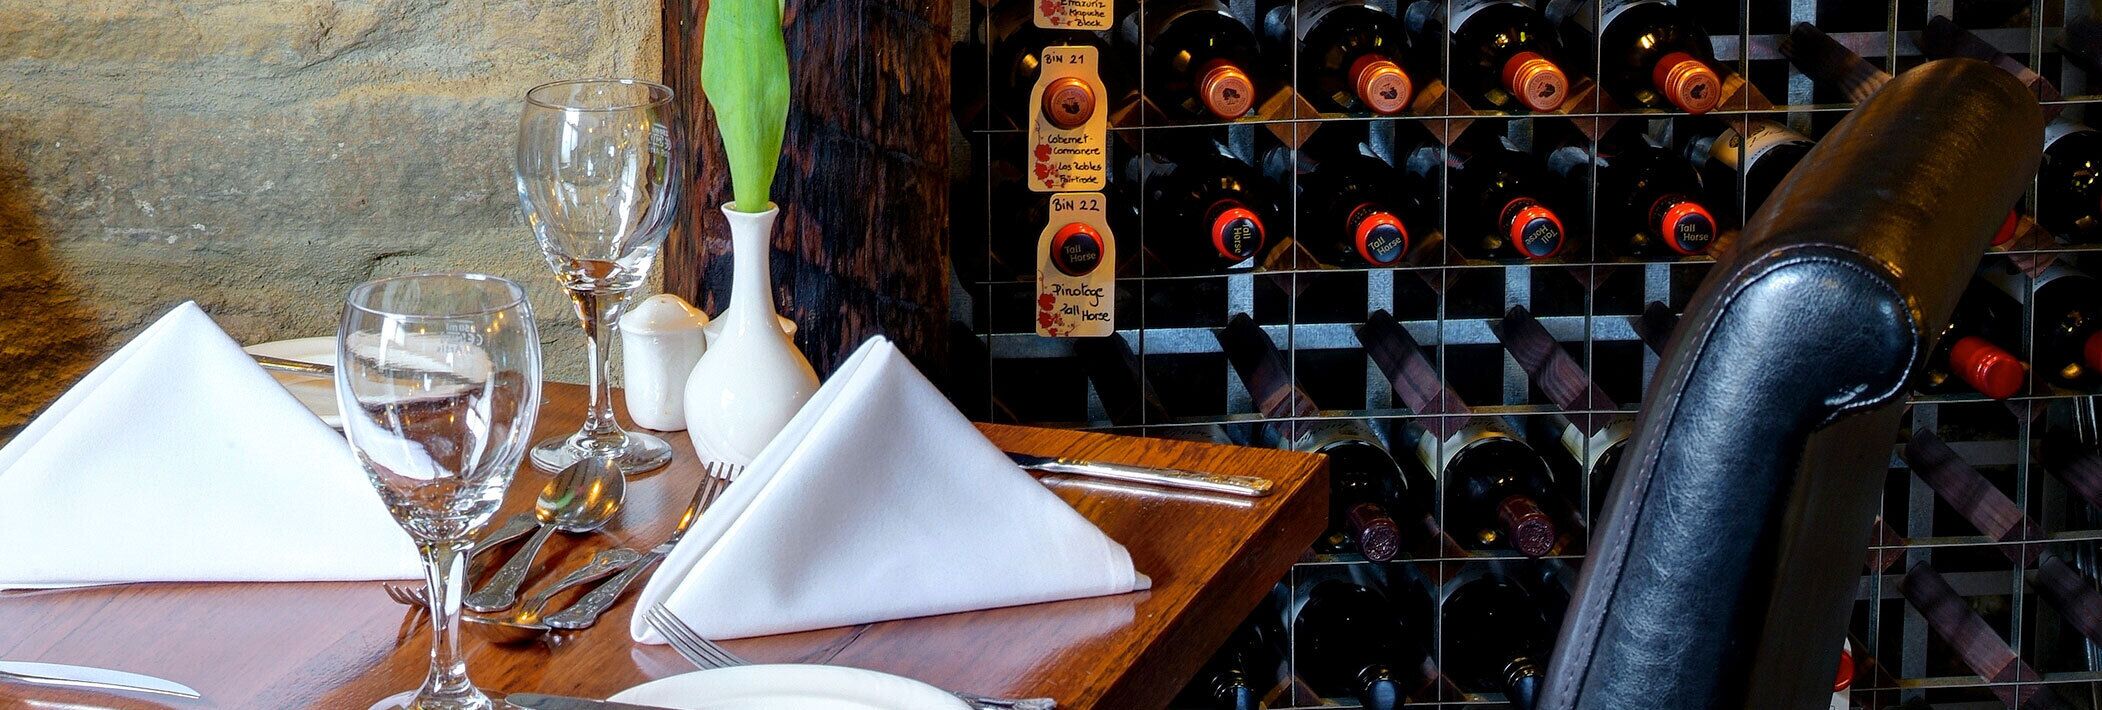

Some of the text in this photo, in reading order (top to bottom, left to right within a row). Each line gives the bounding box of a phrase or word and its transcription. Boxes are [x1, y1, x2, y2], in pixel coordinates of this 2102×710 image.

[1069, 54, 1084, 64] 21
[1080, 199, 1100, 212] 22
[1242, 224, 1251, 239] Tall
[1679, 223, 1696, 232] Tall
[1233, 227, 1242, 254] Horse
[1525, 224, 1549, 245] Horse
[1541, 229, 1558, 244] Tall
[1683, 232, 1709, 241] Horse
[1064, 244, 1081, 254] Tall
[1367, 236, 1385, 250] Tall
[1377, 237, 1402, 256] Horse
[1070, 252, 1097, 262] Horse
[1082, 310, 1110, 321] Horse
